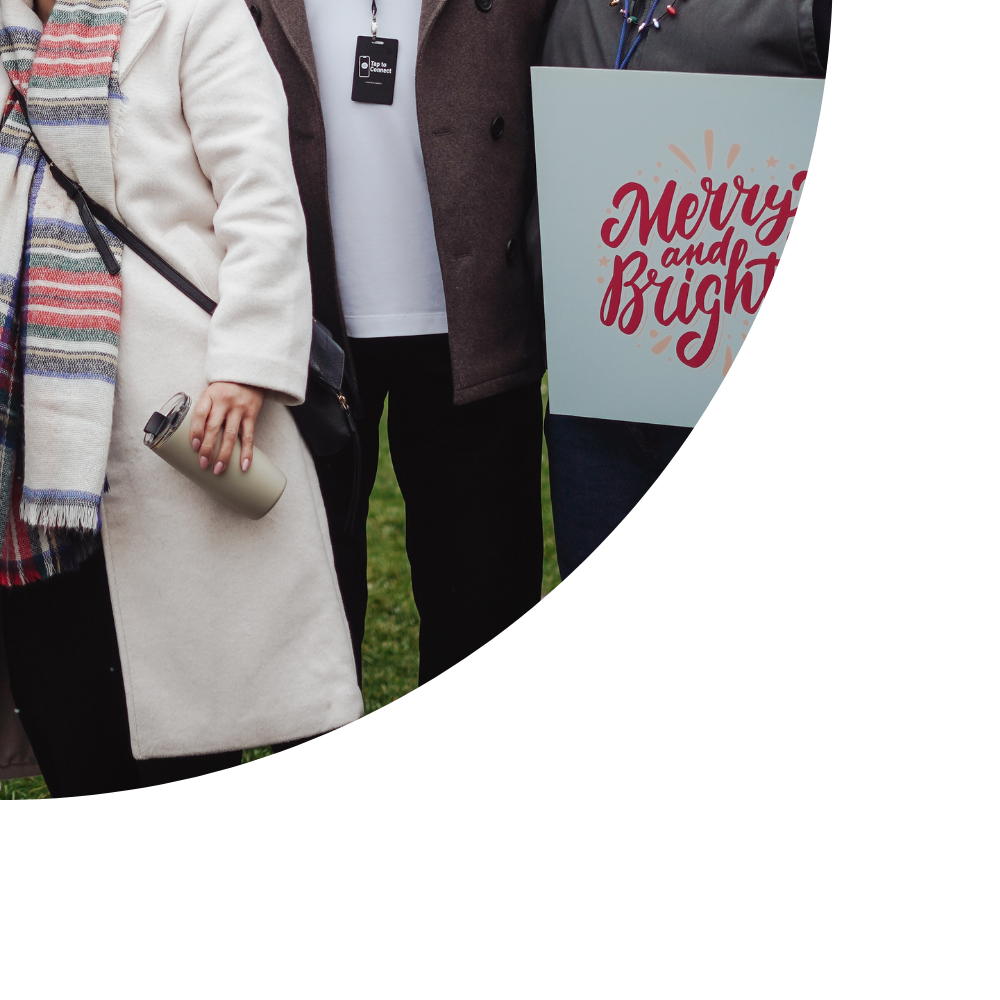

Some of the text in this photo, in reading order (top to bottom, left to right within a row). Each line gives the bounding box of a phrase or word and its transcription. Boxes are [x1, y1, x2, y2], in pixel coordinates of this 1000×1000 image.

[600, 170, 808, 248] Merry
[661, 226, 735, 268] and
[600, 239, 781, 368] Bright
